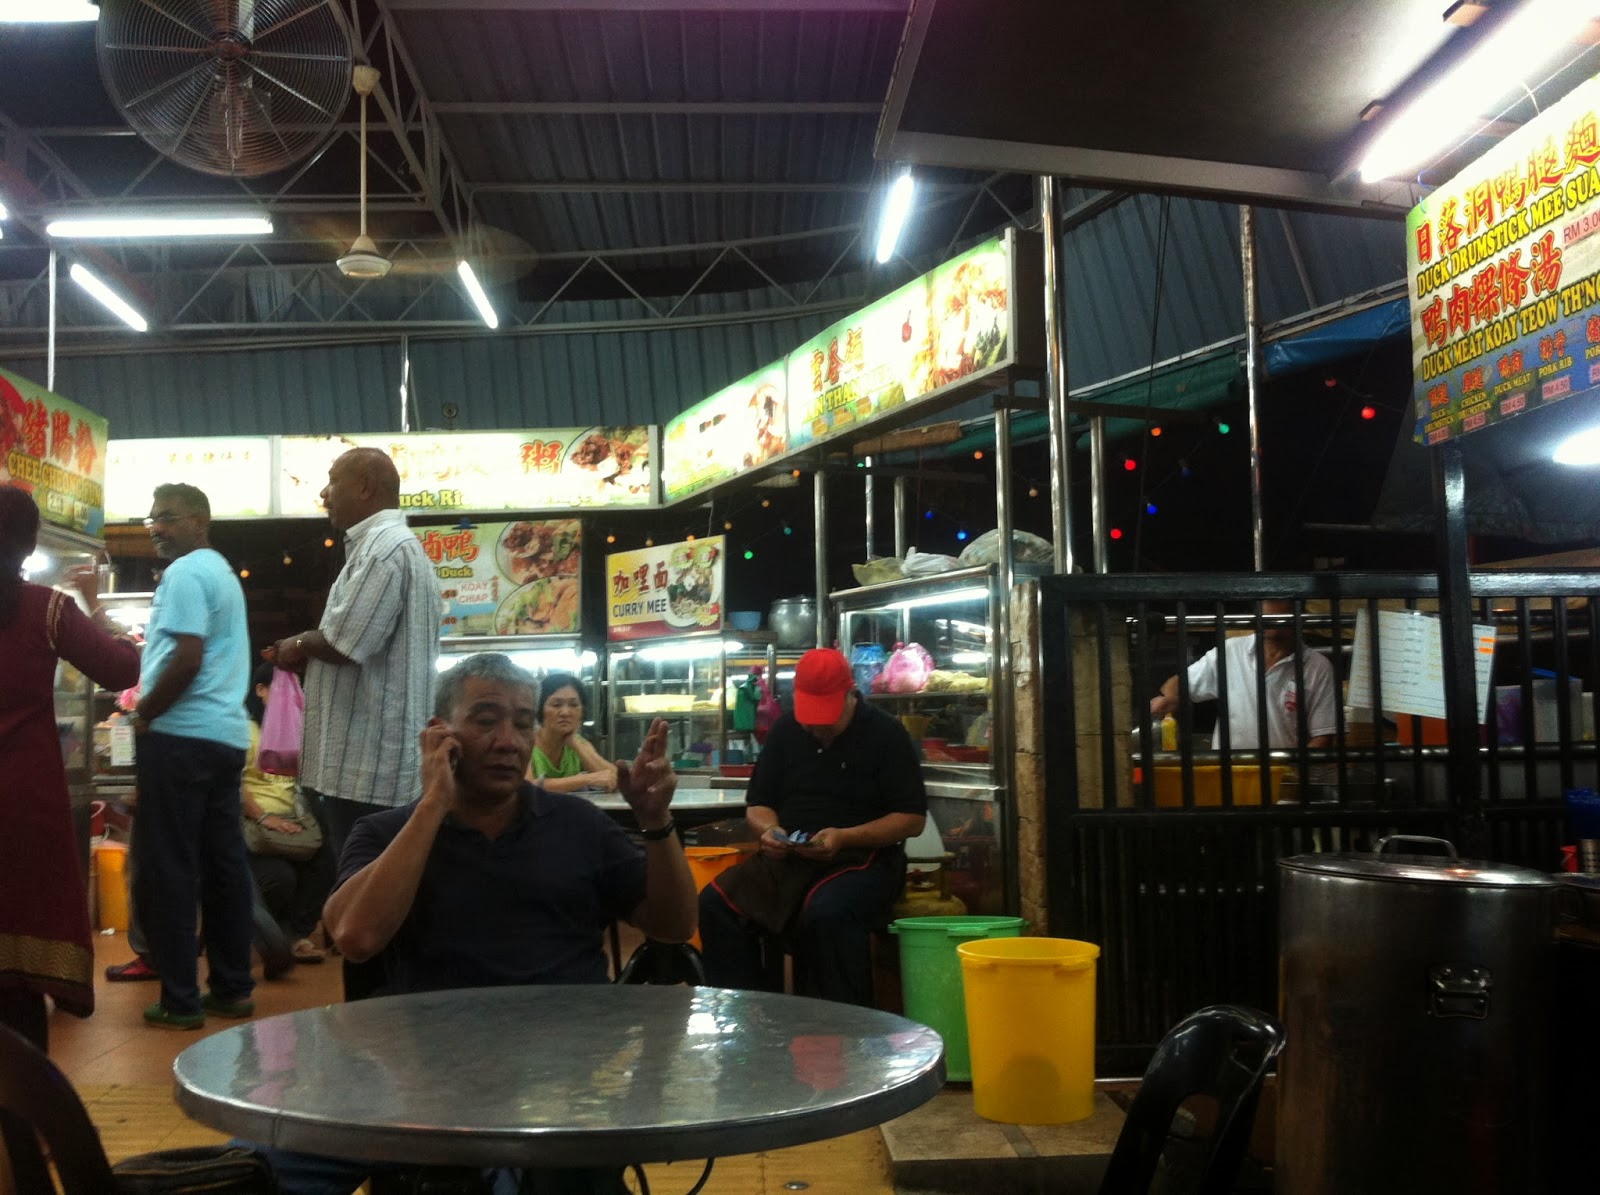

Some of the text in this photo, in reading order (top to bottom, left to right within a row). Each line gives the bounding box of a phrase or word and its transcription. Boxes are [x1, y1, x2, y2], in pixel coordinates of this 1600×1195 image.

[1417, 258, 1450, 299] DUCK
[1450, 207, 1531, 279] DRUMSTICK
[1530, 187, 1566, 231] MEE
[1563, 221, 1581, 243] RM
[1422, 347, 1453, 382] DUCK
[1452, 329, 1485, 366] MEAT
[1484, 312, 1519, 352] KOAY
[1519, 293, 1559, 336] TEOW
[1559, 355, 1573, 370] RIB
[1494, 372, 1533, 396] DUCK MEAT
[8, 449, 41, 485] CHEE
[398, 490, 437, 508] uck
[441, 566, 473, 578] Duck
[613, 599, 667, 618] CURRY MEE
